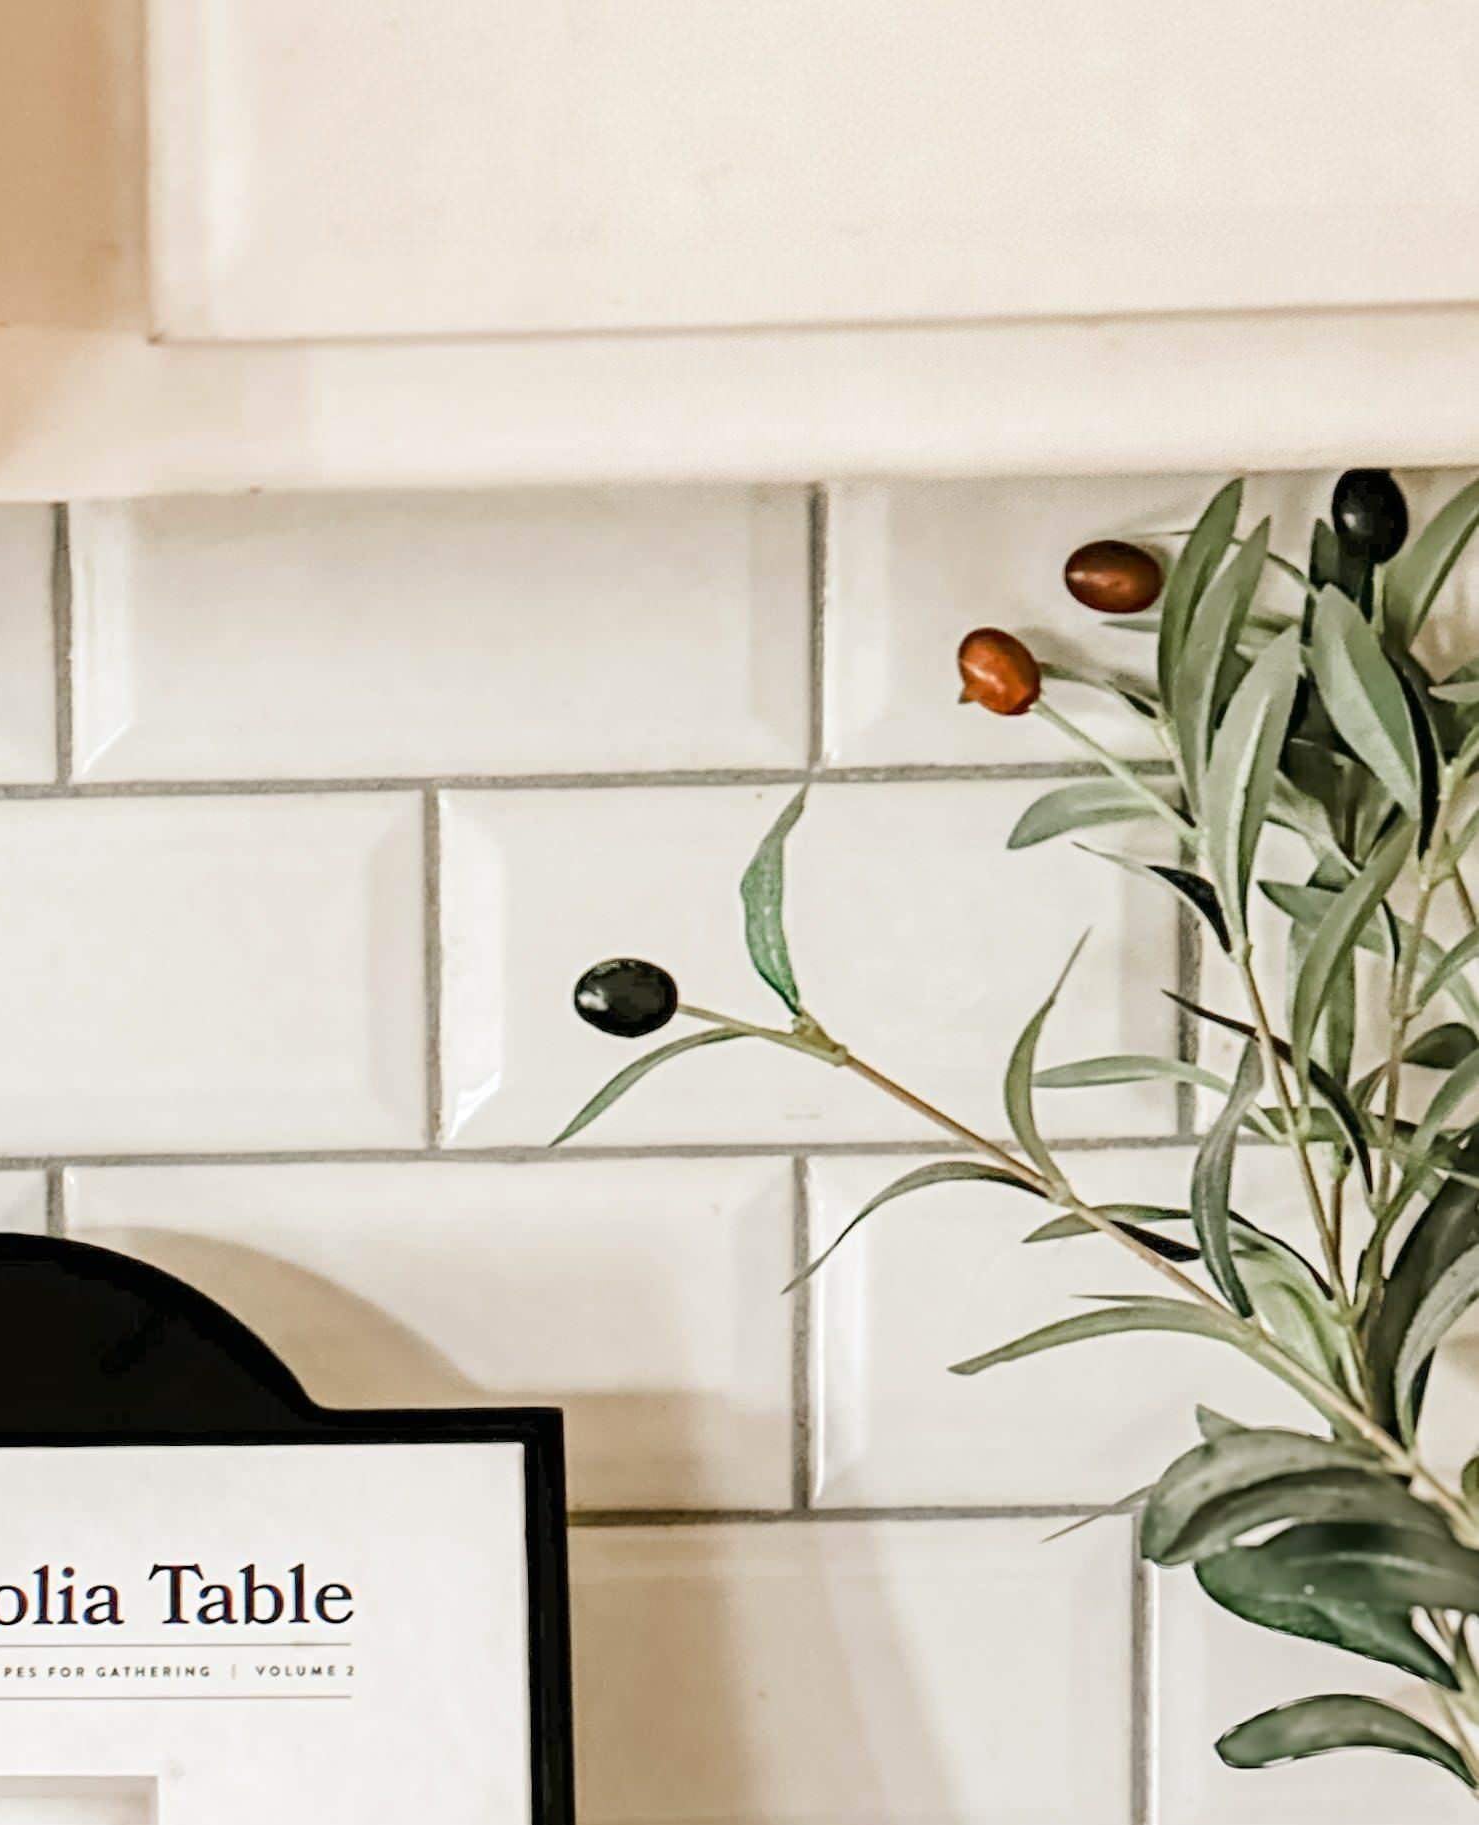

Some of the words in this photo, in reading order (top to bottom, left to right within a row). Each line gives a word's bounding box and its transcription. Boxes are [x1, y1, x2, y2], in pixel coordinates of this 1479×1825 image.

[148, 1563, 355, 1625] Table
[48, 1666, 85, 1678] FOR
[96, 1665, 211, 1678] GATHERING
[255, 1664, 337, 1677] VOLUME
[346, 1665, 356, 1677] 2
